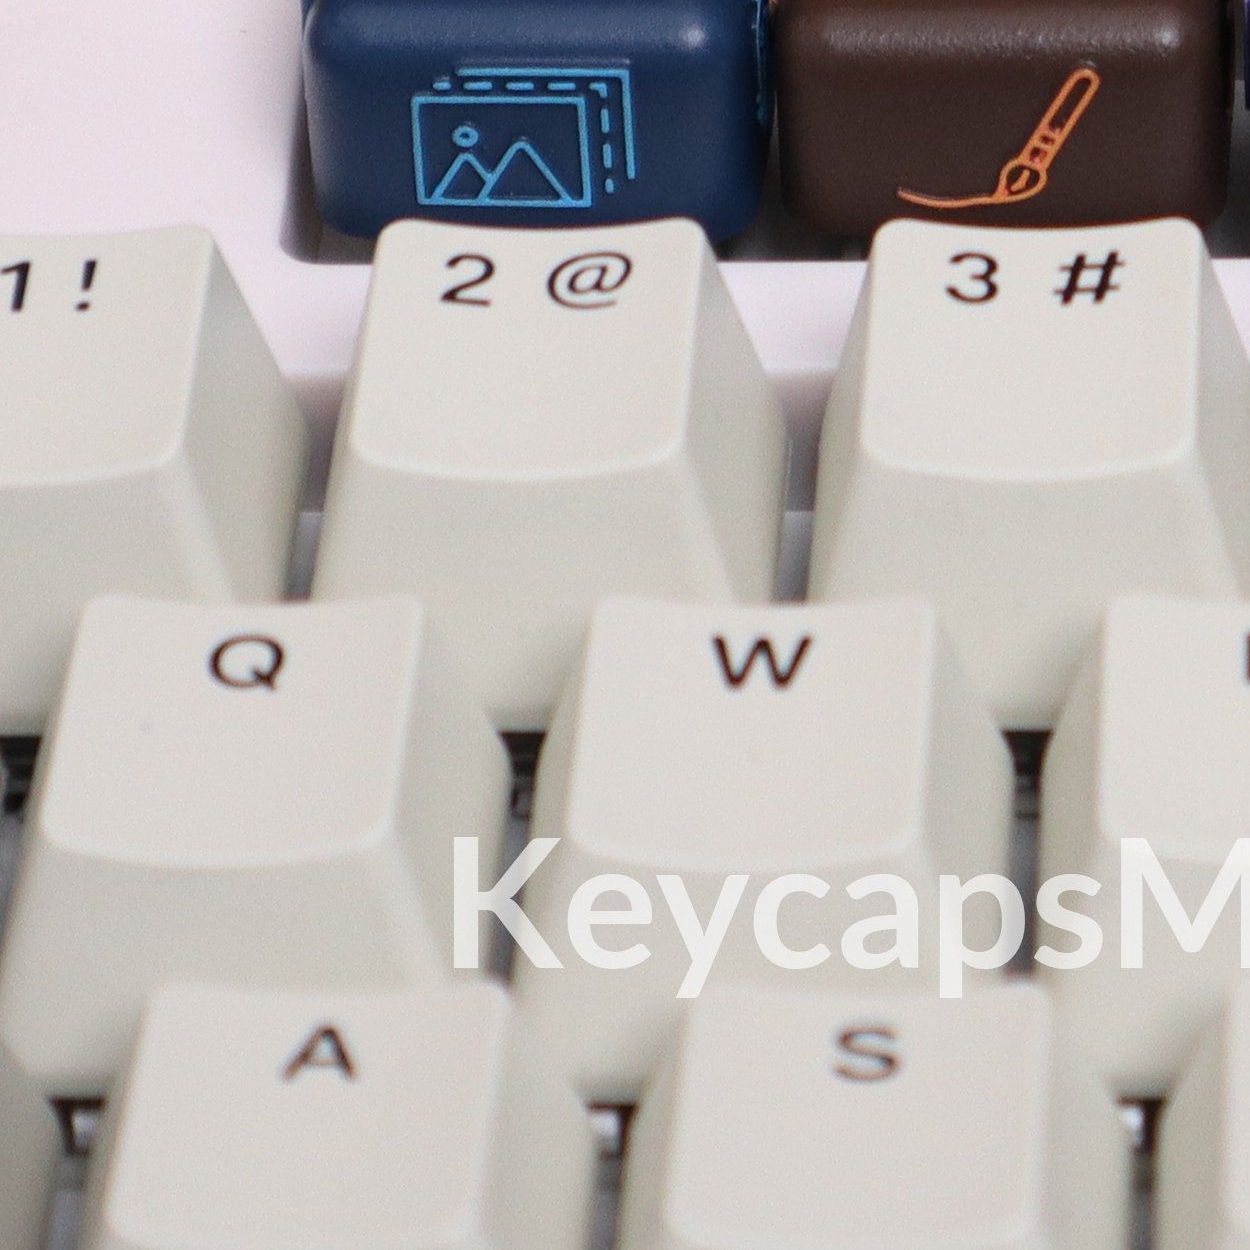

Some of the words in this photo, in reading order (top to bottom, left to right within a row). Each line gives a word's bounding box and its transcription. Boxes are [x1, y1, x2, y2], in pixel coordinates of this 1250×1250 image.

[0, 259, 32, 313] 1
[74, 258, 99, 312] !
[439, 252, 496, 308] 2
[545, 250, 634, 310] @
[944, 251, 1000, 306] 3
[1053, 249, 1126, 307] #
[207, 632, 287, 691] Q
[710, 634, 814, 691] W
[281, 1022, 360, 1082] A
[833, 1024, 903, 1082] S
